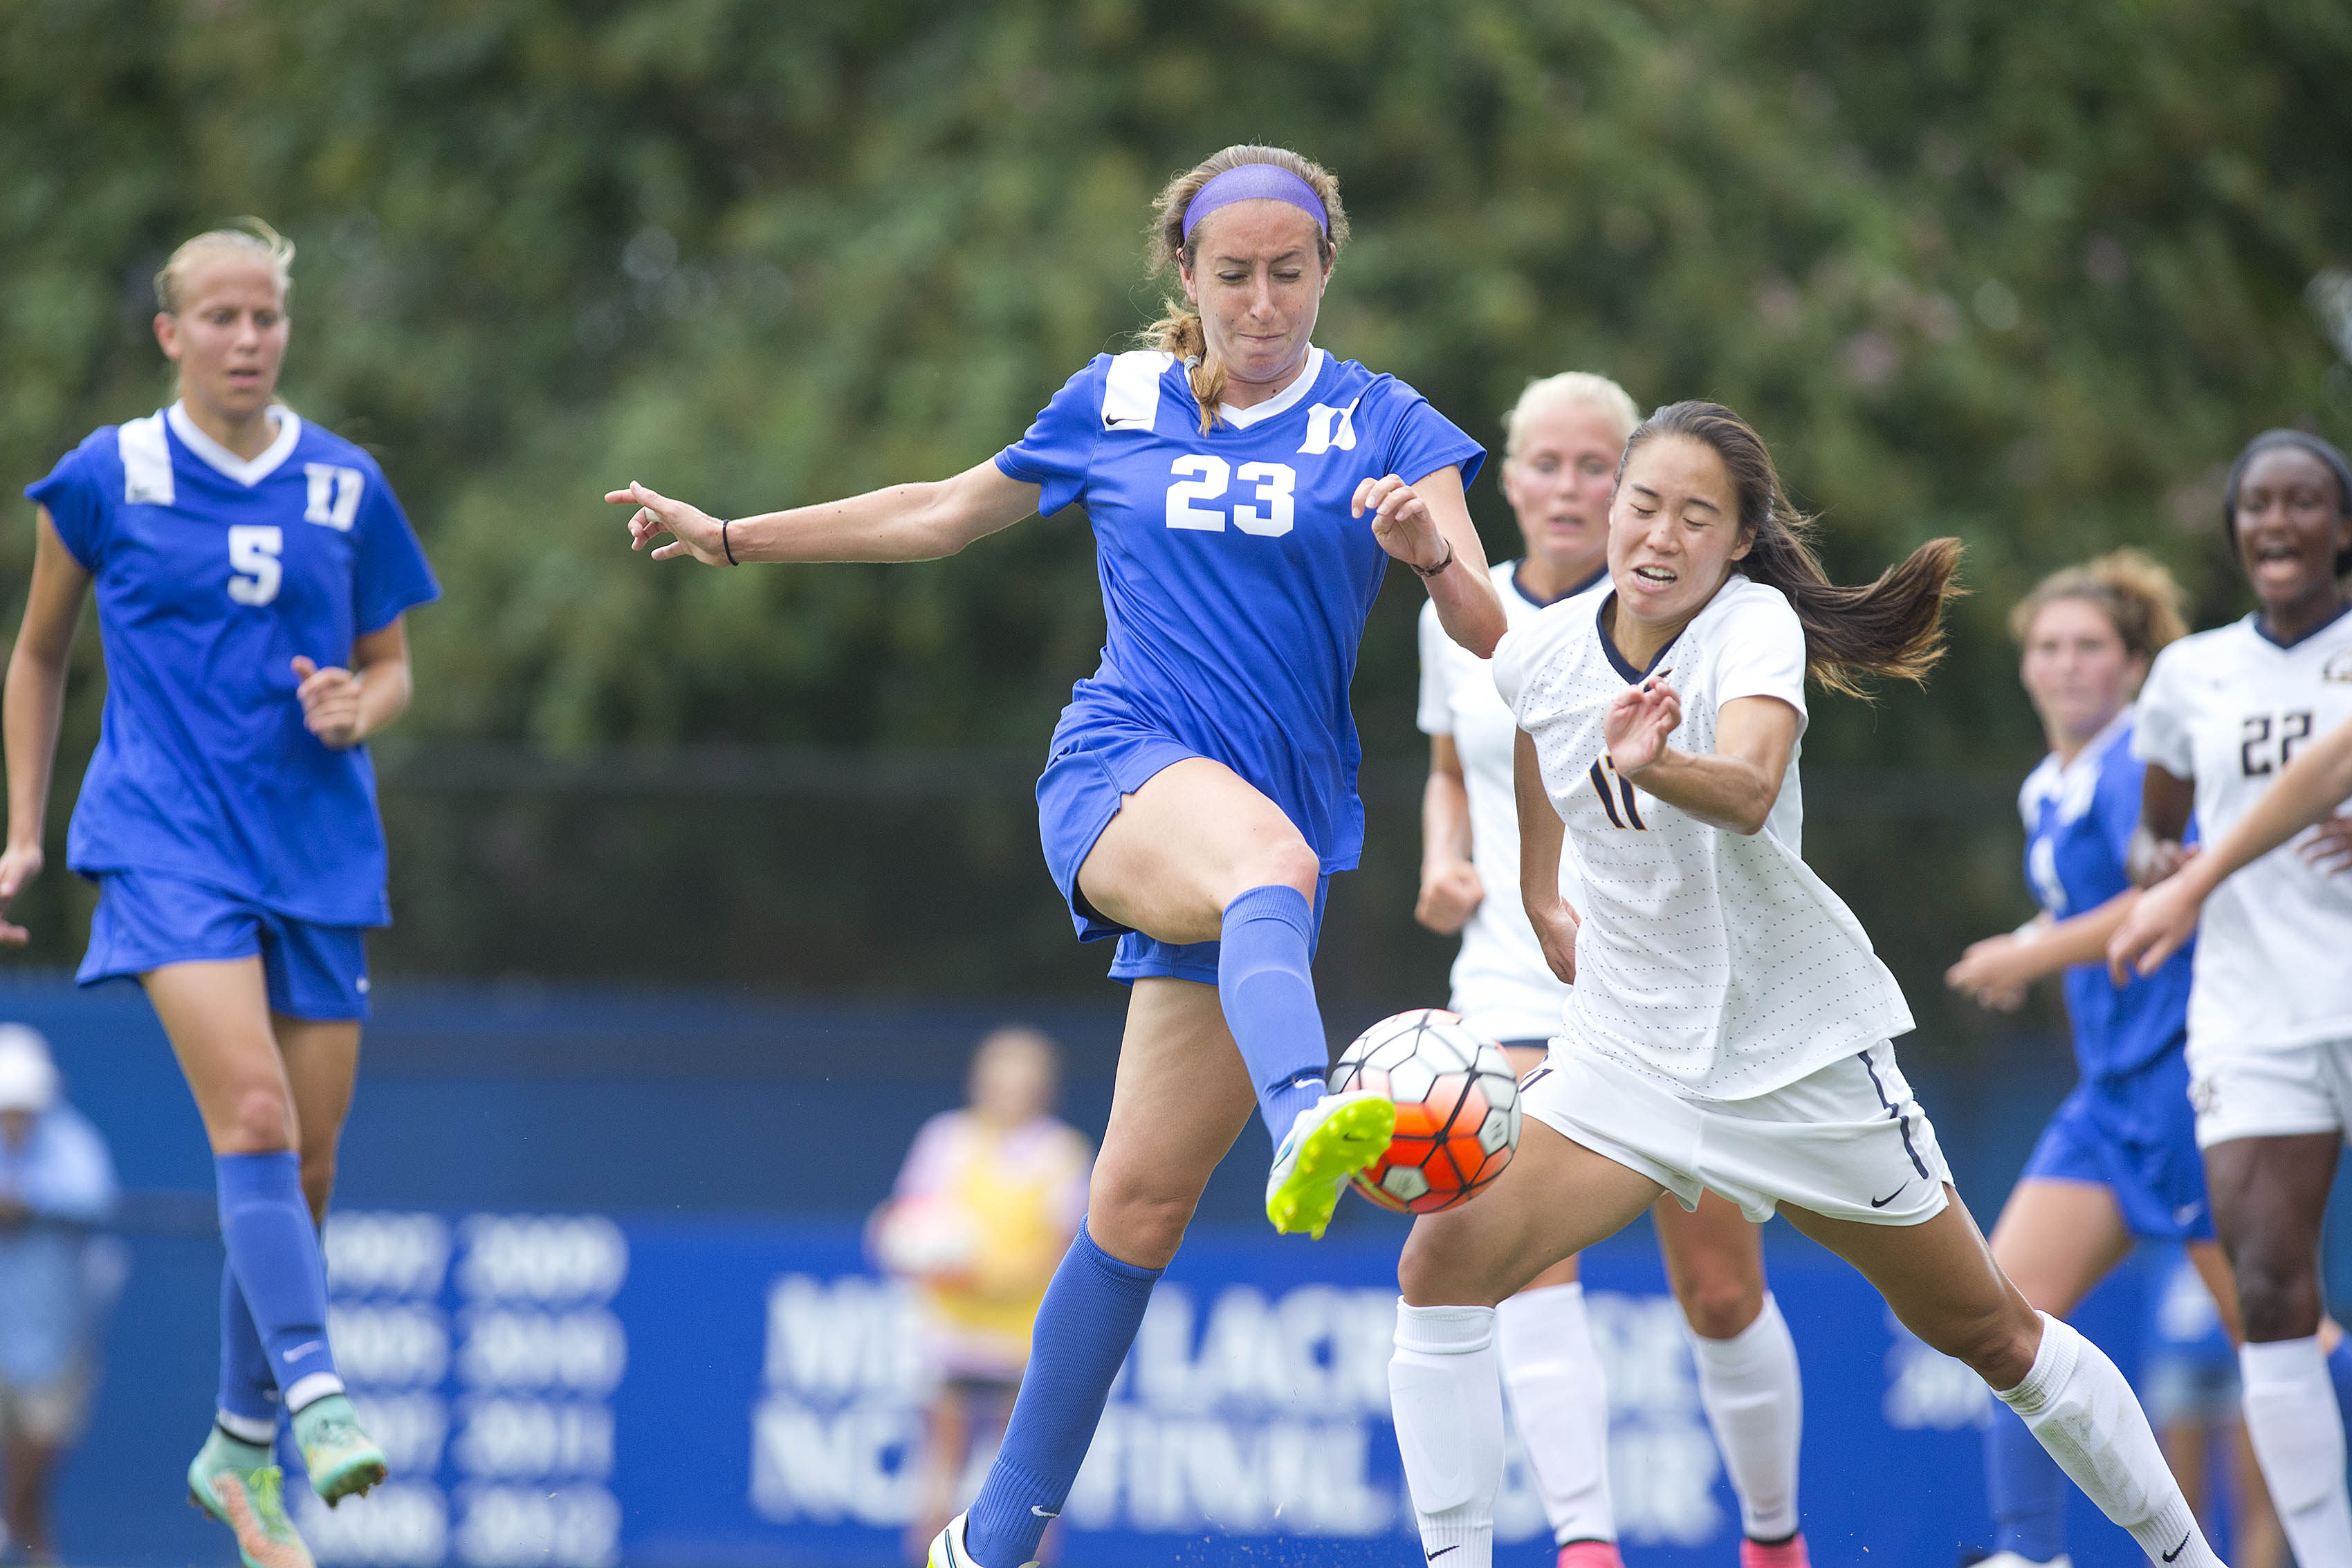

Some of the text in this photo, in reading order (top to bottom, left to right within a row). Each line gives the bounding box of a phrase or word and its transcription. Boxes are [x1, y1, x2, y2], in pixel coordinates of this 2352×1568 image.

[1166, 454, 1296, 537] 23
[228, 525, 283, 607] 5
[2240, 709, 2313, 779] 22
